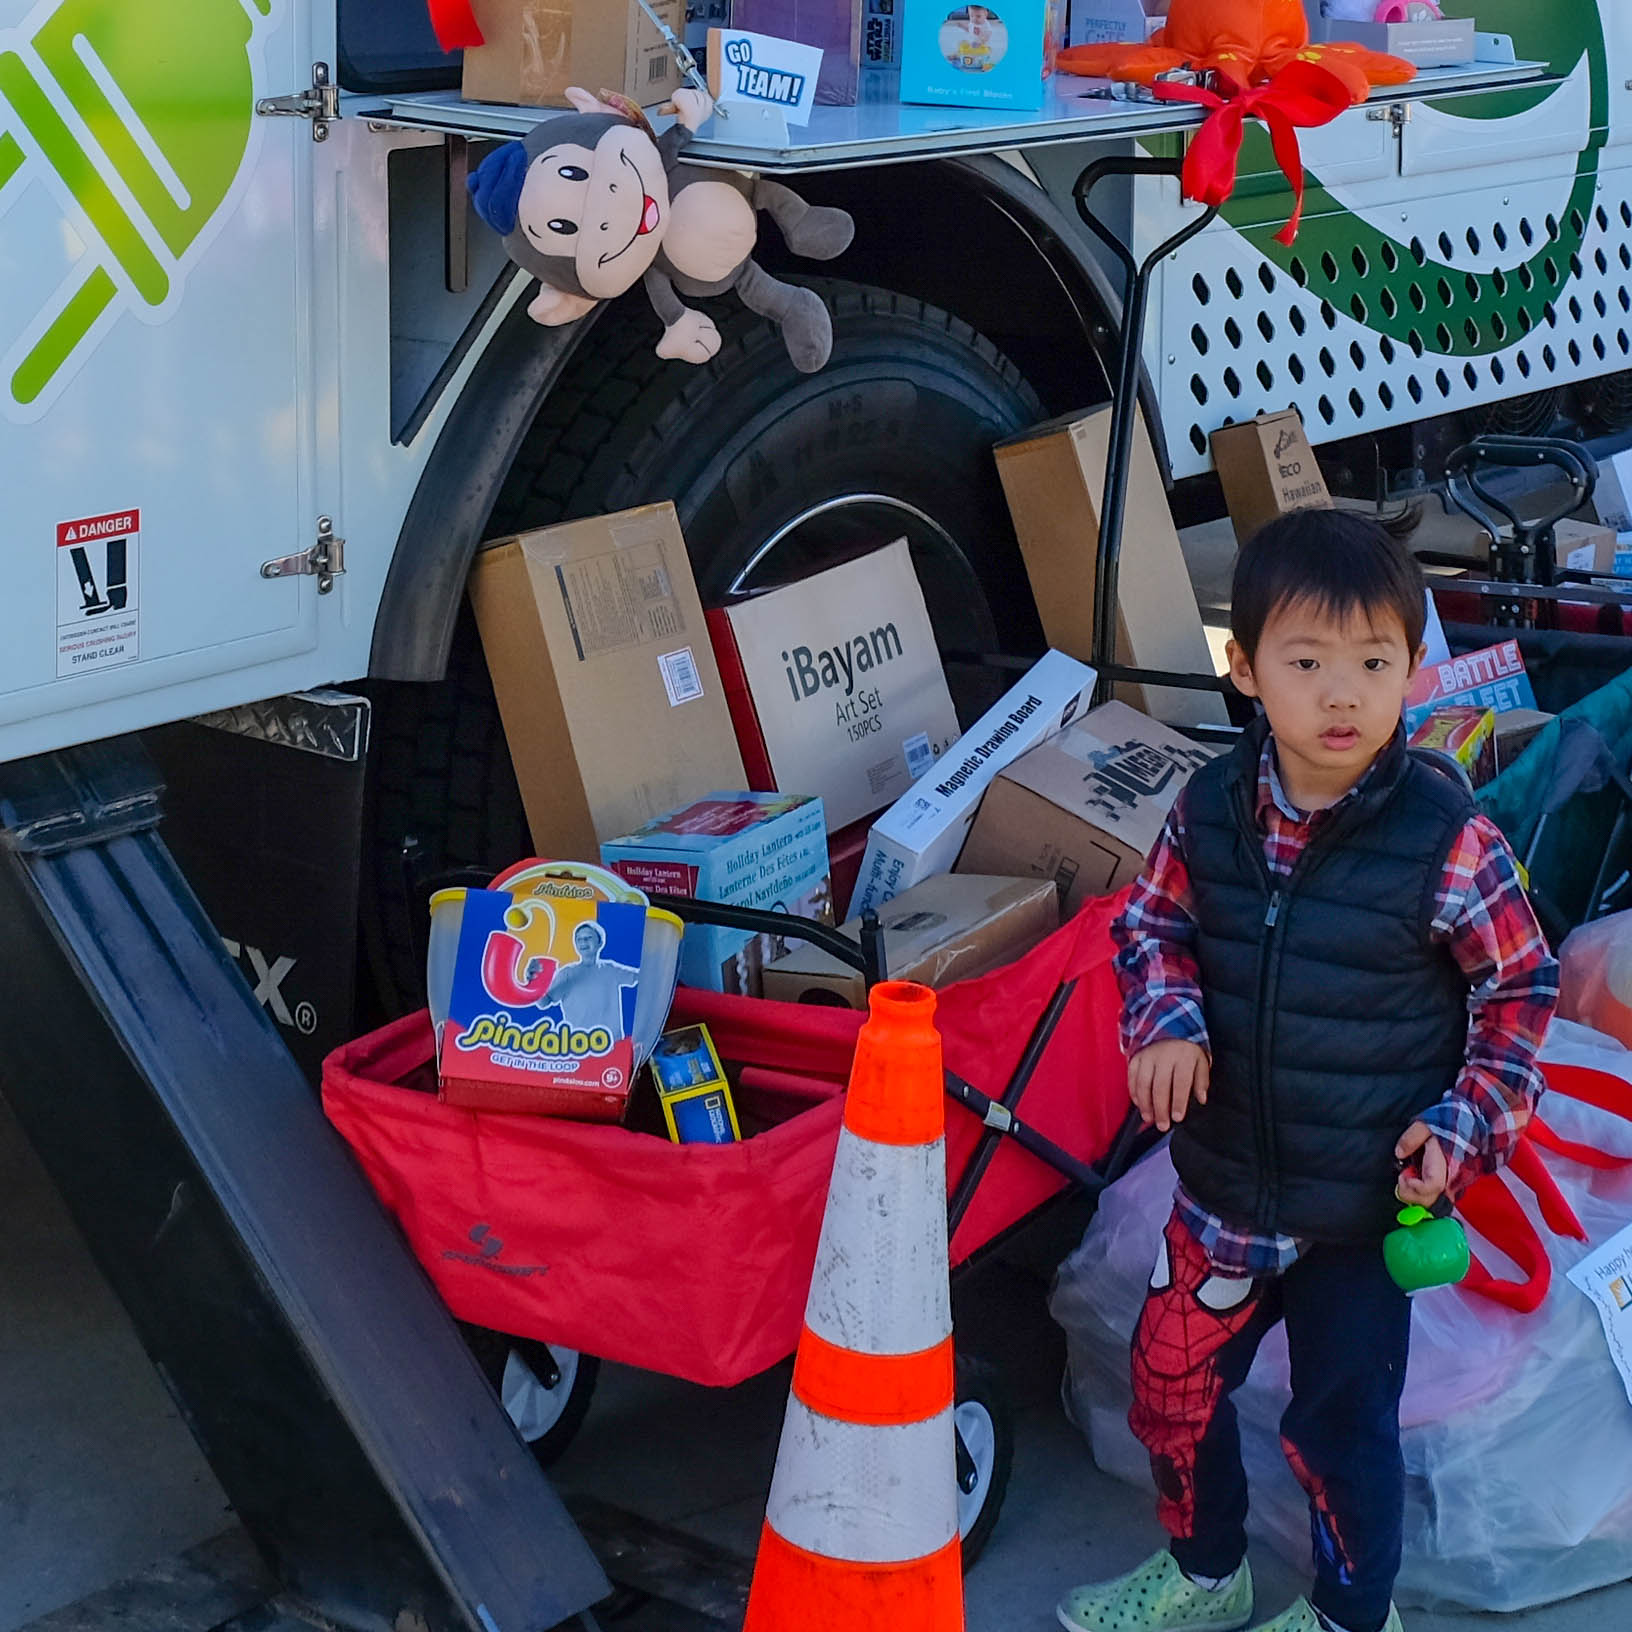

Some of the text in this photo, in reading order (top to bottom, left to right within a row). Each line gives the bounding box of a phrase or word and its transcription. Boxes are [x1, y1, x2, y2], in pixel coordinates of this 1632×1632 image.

[1085, 18, 1126, 30] PERFECTLY
[727, 42, 751, 63] GO
[738, 67, 802, 103] TEAM!
[927, 85, 1013, 99] Baby's First Blocks
[1279, 462, 1301, 478] ECO
[79, 516, 132, 539] DANGER
[71, 644, 125, 664] STAND CLEAR
[781, 622, 903, 702] iBayam
[1438, 644, 1521, 693] BATTLE
[835, 686, 883, 727] Art Set
[846, 714, 882, 743] 150PCS
[934, 694, 1044, 798] Magnetic Drawing Board
[726, 831, 793, 875] Holiday Lantern
[626, 866, 681, 879] Holiday Lantern
[719, 850, 798, 900] Lanterne Des Fêtes
[884, 858, 905, 890] Enjoy
[533, 881, 594, 900] pindaloo
[655, 885, 688, 896] Des Fêtes
[754, 873, 794, 905] Navideño
[458, 1014, 610, 1056] pindaloo
[491, 1054, 578, 1072] GET IN THE LOOP
[552, 1075, 600, 1088] pindaloo.com
[606, 1072, 619, 1084] 9+
[1594, 1252, 1627, 1281] Happy
